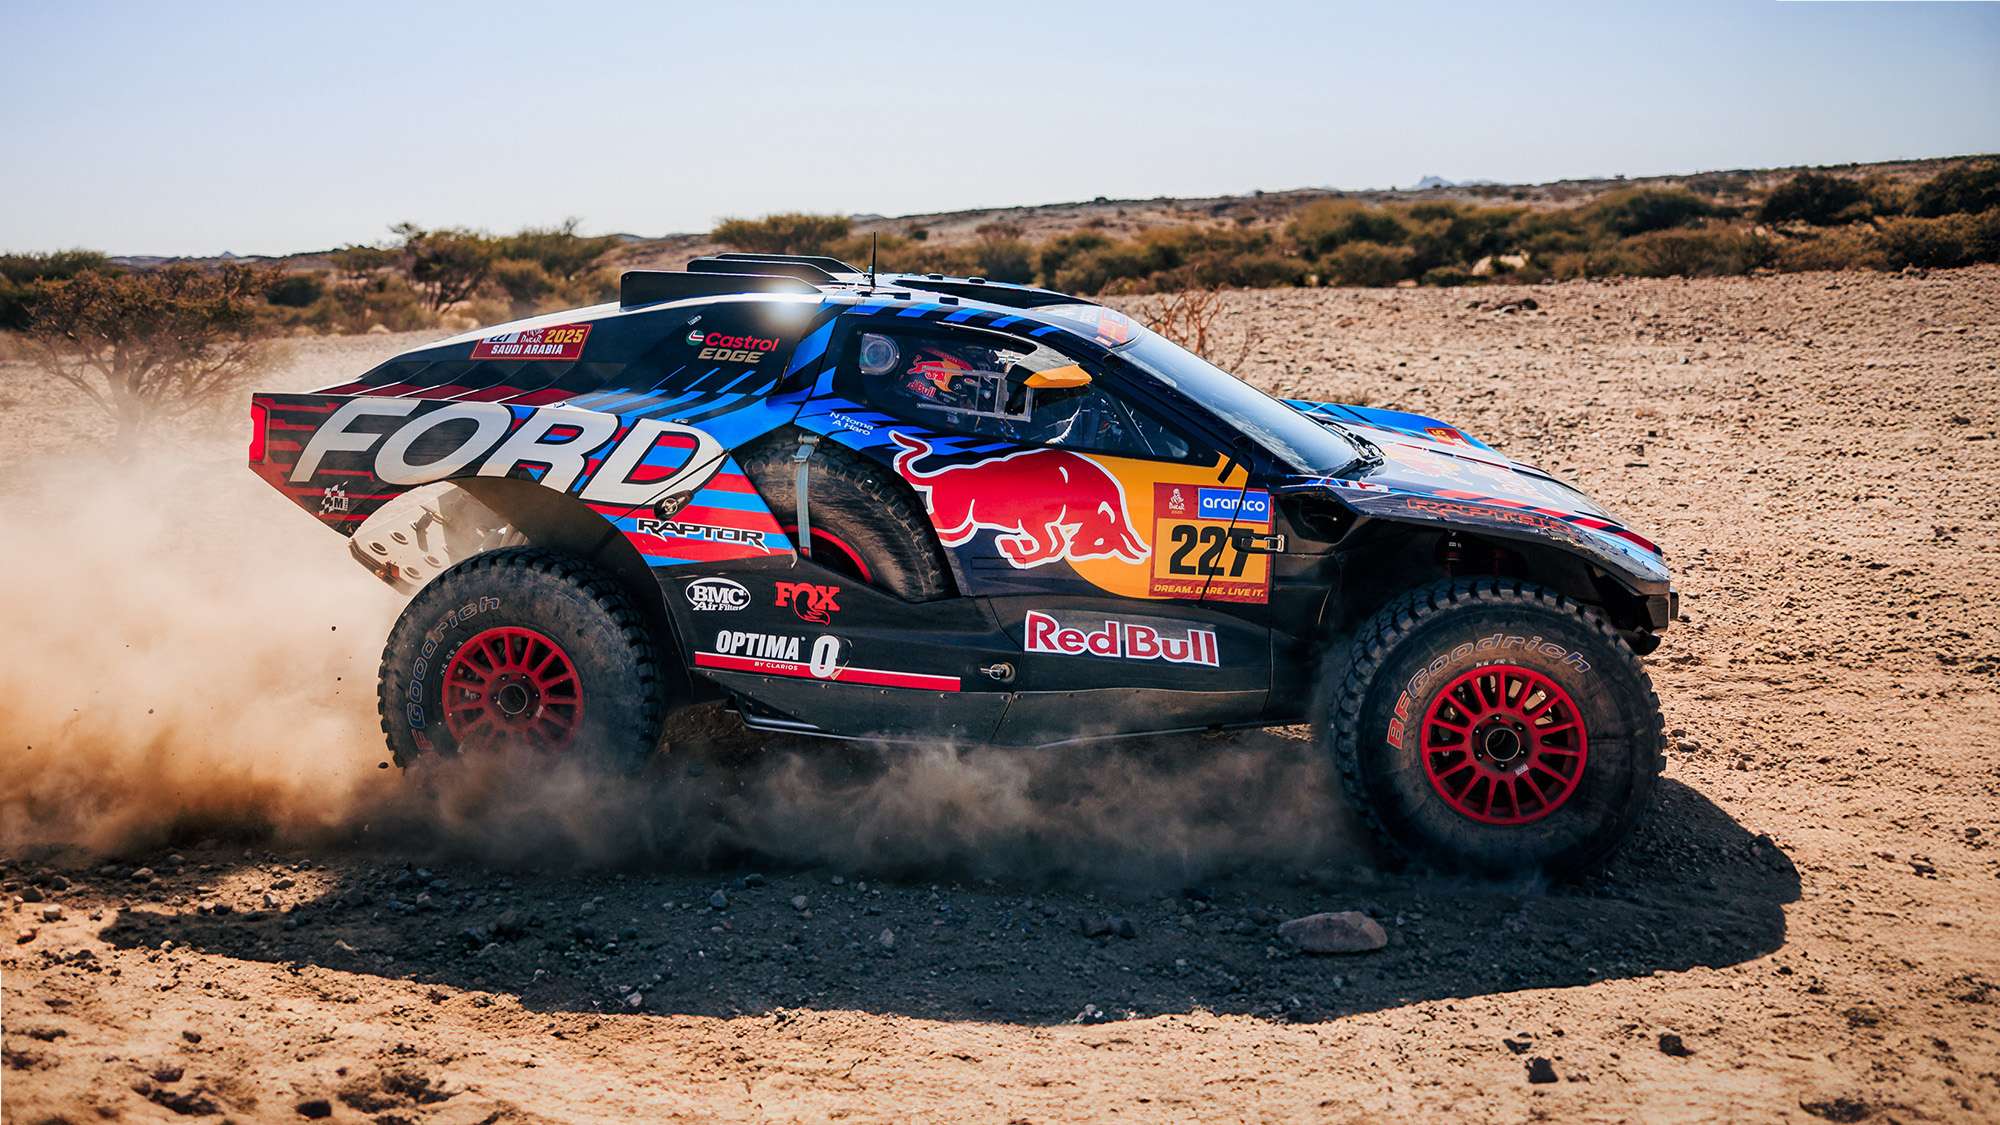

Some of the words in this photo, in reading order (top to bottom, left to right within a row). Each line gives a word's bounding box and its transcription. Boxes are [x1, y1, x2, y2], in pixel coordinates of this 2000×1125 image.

[544, 328, 585, 344] 2025
[705, 332, 780, 352] Castrol
[490, 344, 523, 355] SAUDI
[523, 344, 564, 355] ARABIA
[698, 347, 765, 364] EDGE
[830, 411, 840, 419] N
[840, 415, 874, 431] Roma
[832, 419, 842, 427] A
[843, 422, 871, 436] Haro
[289, 399, 728, 504] FORD
[1202, 497, 1266, 512] aramco
[636, 518, 771, 554] RAPTOR
[1169, 524, 1255, 578] 227
[692, 585, 745, 605] BMC
[1154, 584, 1194, 595] DREAM.
[1228, 588, 1250, 598] LIVE
[1251, 589, 1265, 598] IT.
[693, 601, 718, 611] Air
[775, 581, 841, 622] FOX
[715, 630, 801, 661] OPTIMA
[1025, 610, 1121, 657] Red
[1126, 624, 1219, 667] Bull
[766, 662, 799, 671] CLARIOS
[1386, 633, 1592, 750] BFGoodrich
